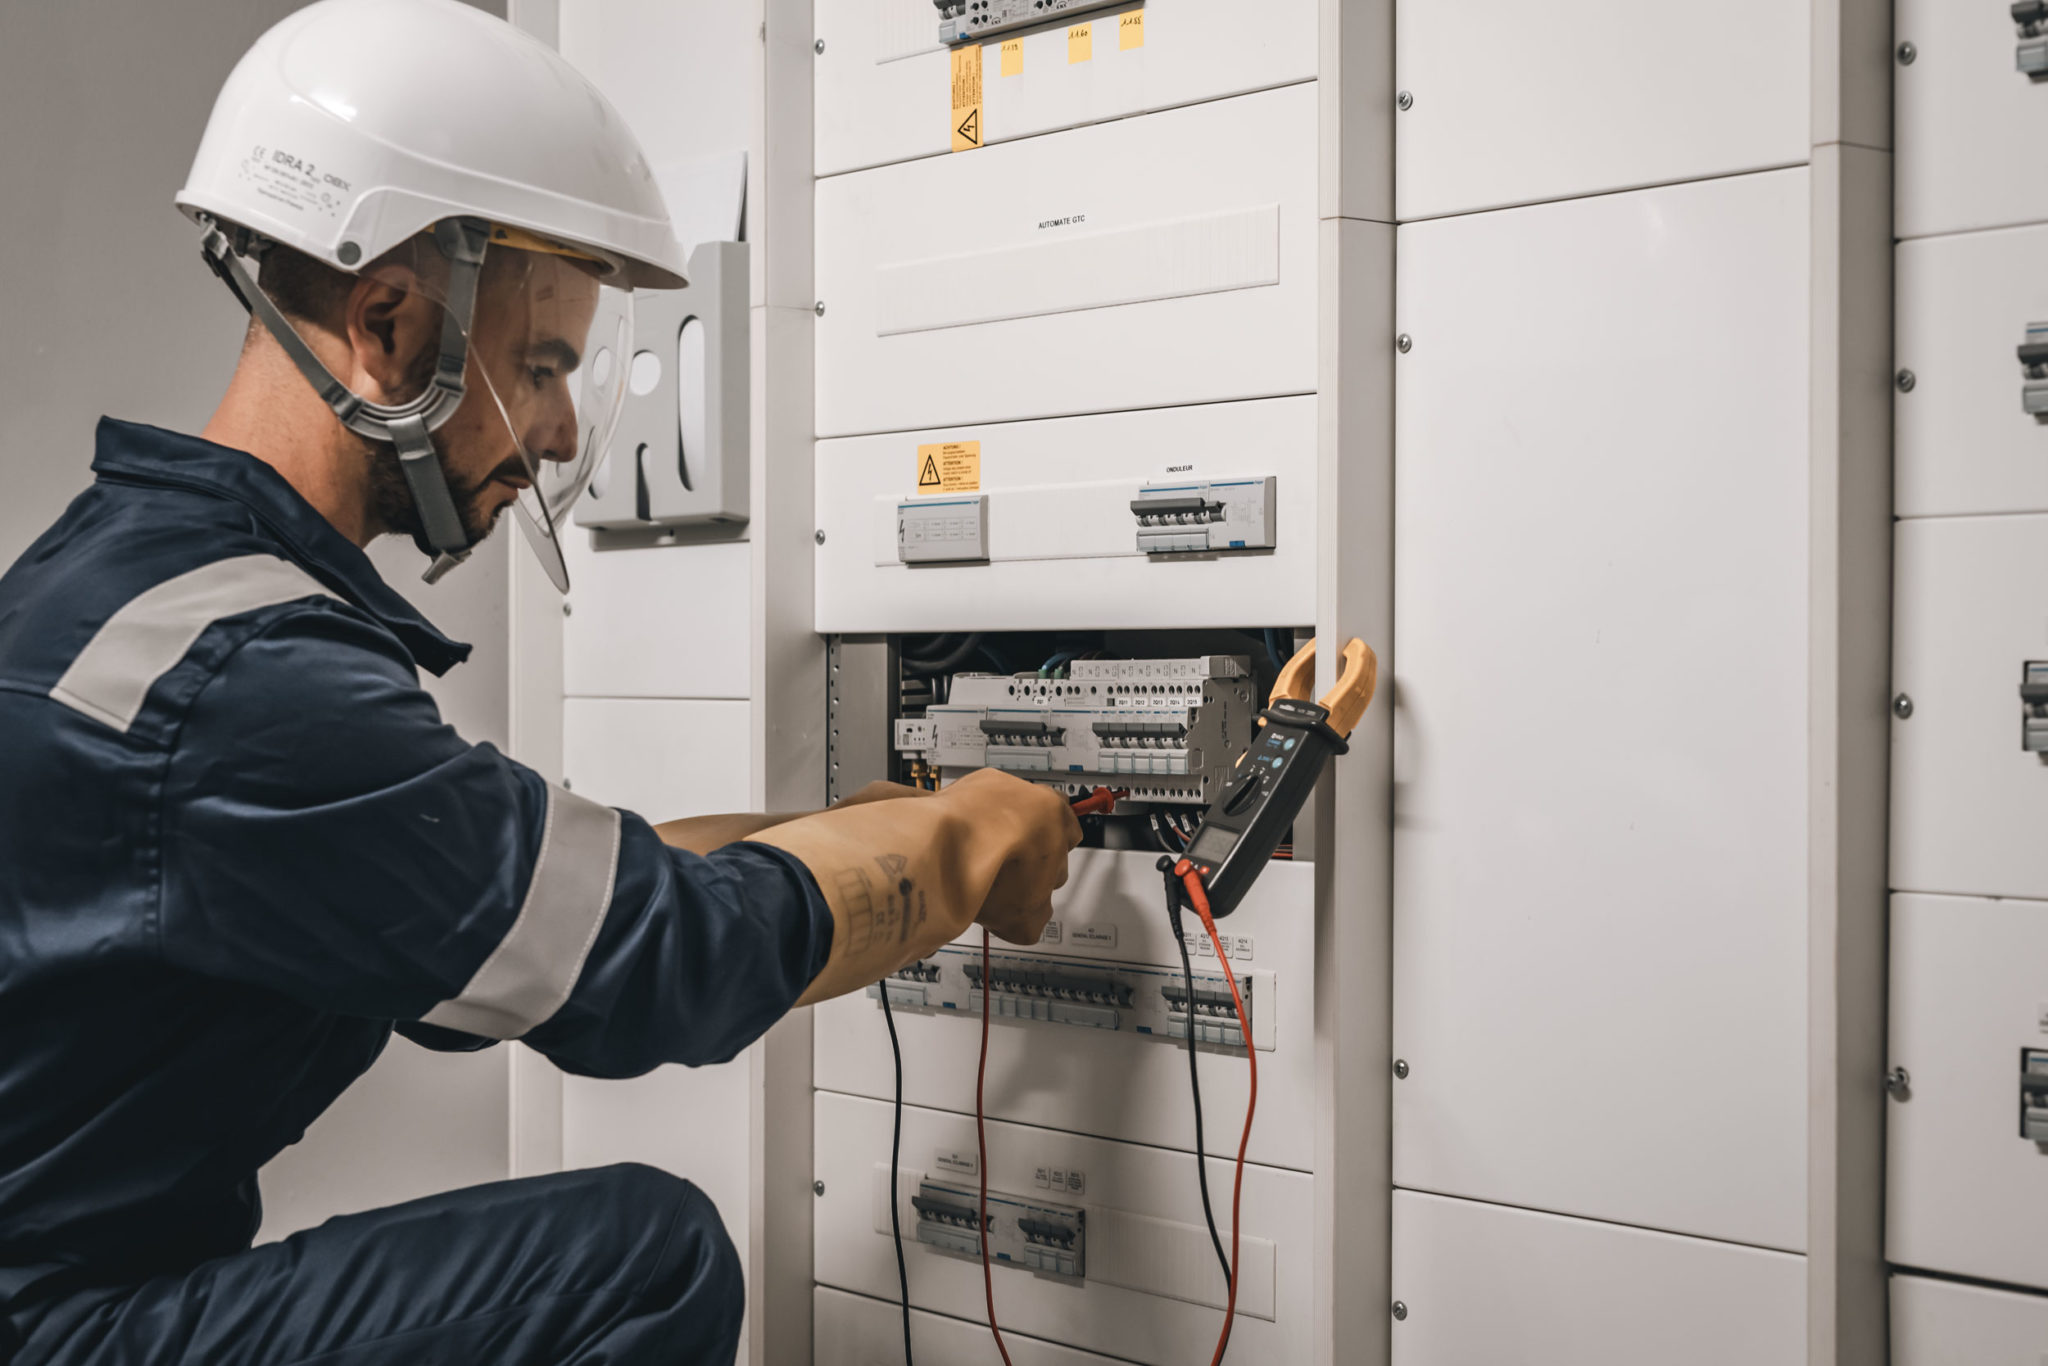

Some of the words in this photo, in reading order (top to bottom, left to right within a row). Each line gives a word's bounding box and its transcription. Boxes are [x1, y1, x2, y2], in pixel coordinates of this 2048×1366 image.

[272, 149, 303, 172] IDRA
[1038, 217, 1071, 229] AUTOMATE
[1072, 214, 1085, 223] GTC
[1166, 464, 1193, 473] ONDULEUR
